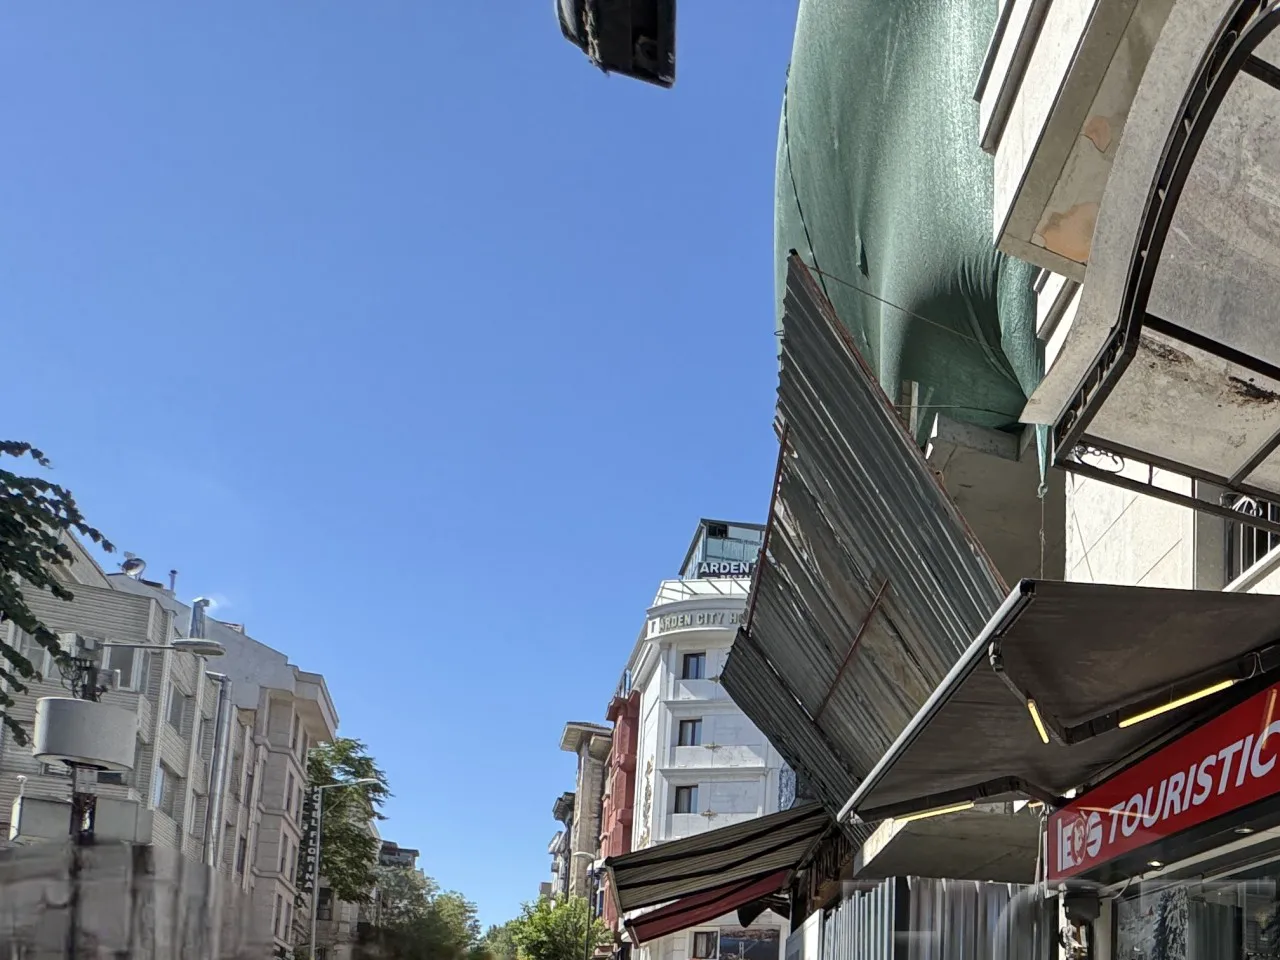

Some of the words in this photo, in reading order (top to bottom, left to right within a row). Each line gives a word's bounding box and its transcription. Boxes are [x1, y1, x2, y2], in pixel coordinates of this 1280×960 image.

[700, 562, 750, 574] ARDEN
[660, 614, 693, 631] ARDEN
[696, 612, 725, 625] CITY
[304, 831, 317, 889] FLORINA
